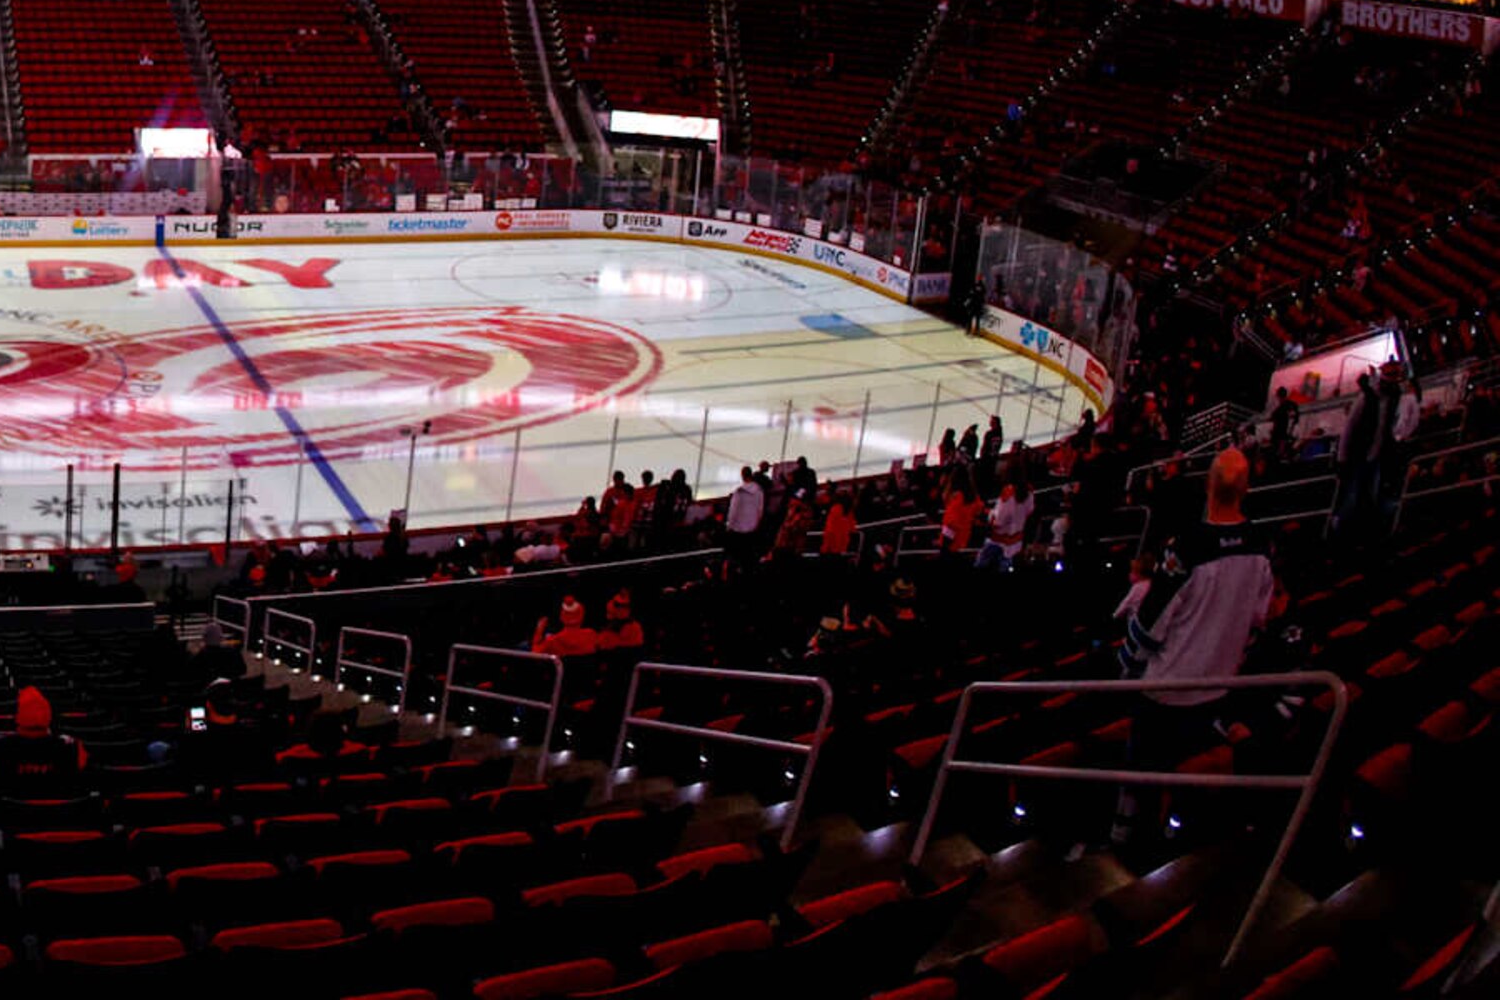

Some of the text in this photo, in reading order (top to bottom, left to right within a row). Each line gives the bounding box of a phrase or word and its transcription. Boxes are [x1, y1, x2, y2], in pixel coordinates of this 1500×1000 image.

[1341, 0, 1471, 41] BROTHERS
[388, 217, 468, 232] ticketmaster
[28, 258, 342, 297] DAY
[1050, 339, 1065, 359] NC
